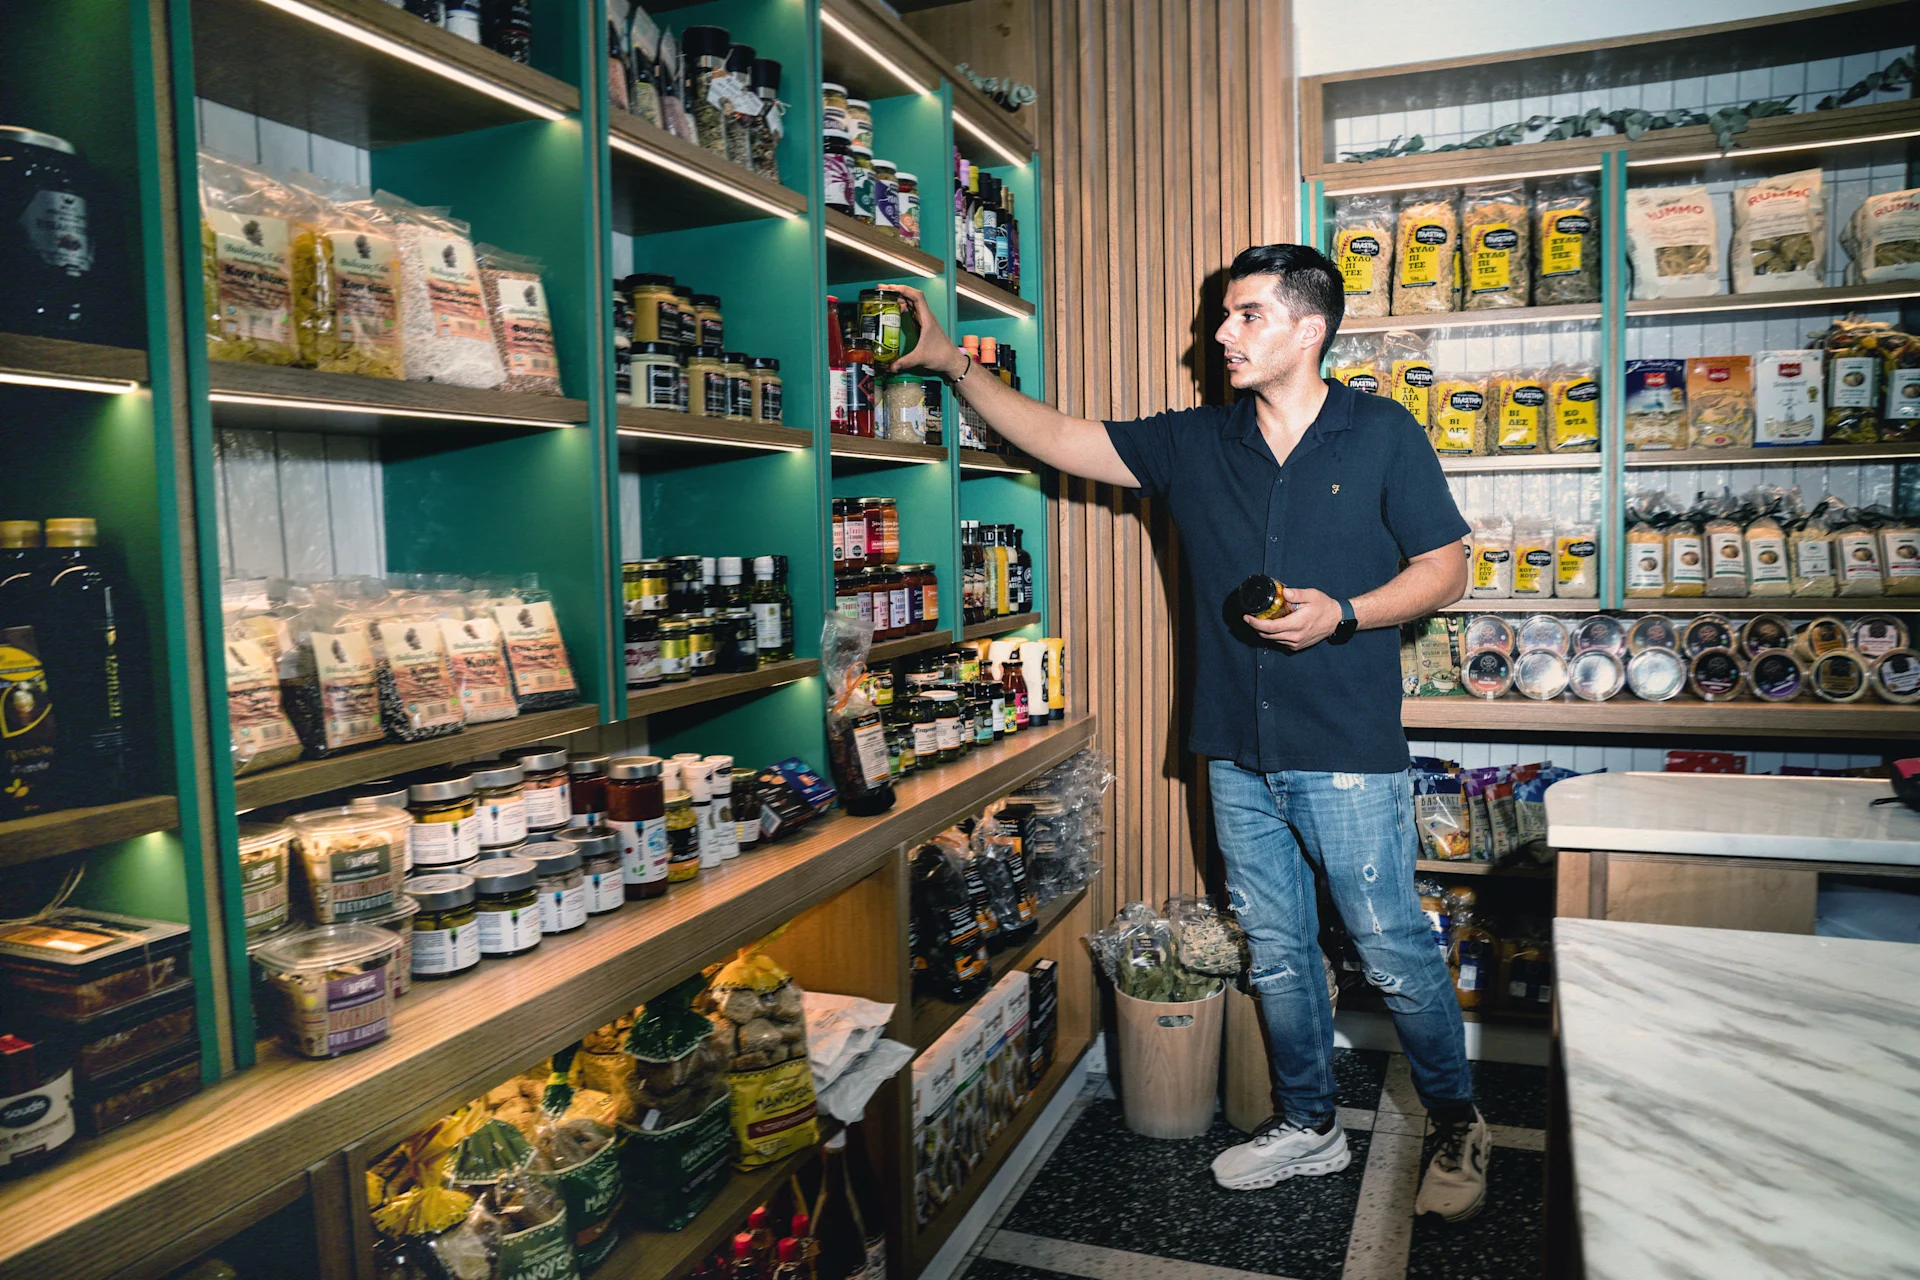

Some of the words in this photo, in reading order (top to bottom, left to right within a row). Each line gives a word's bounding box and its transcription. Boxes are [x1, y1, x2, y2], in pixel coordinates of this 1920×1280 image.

[1409, 246, 1435, 254] ΧΥΛΟ
[1551, 245, 1564, 253] ΠΙ
[1345, 255, 1371, 263] ΧΥΛΟ
[1409, 254, 1419, 262] ΠΙ
[1477, 251, 1506, 259] ΧΥΛΟ
[1551, 251, 1571, 260] ΤΕΣ
[1345, 269, 1362, 277] ΤΕΣ
